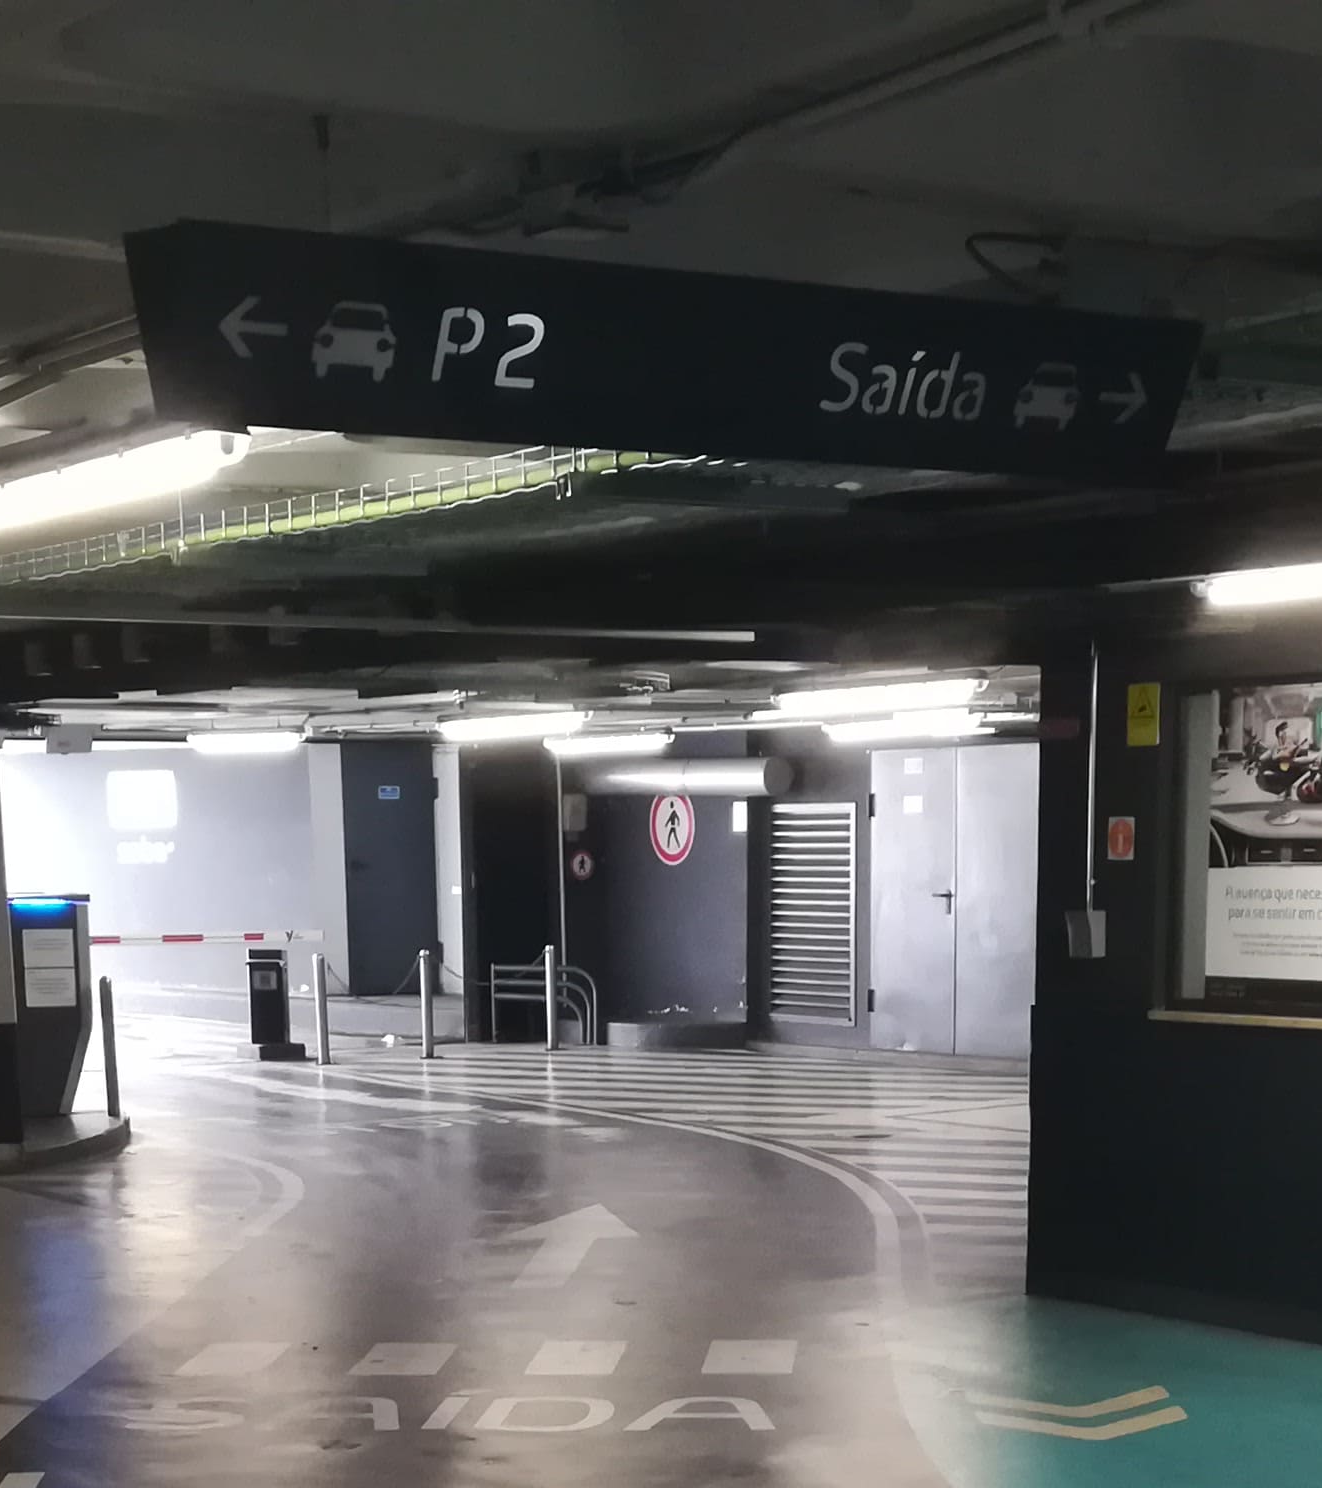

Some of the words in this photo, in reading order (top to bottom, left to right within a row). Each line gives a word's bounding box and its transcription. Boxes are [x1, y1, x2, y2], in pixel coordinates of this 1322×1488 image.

[431, 306, 545, 389] P2
[819, 342, 987, 421] Saída
[1225, 886, 1235, 897] A
[1276, 888, 1295, 903] que
[1228, 907, 1252, 921] para
[1253, 909, 1265, 920] se
[1298, 909, 1316, 920] em
